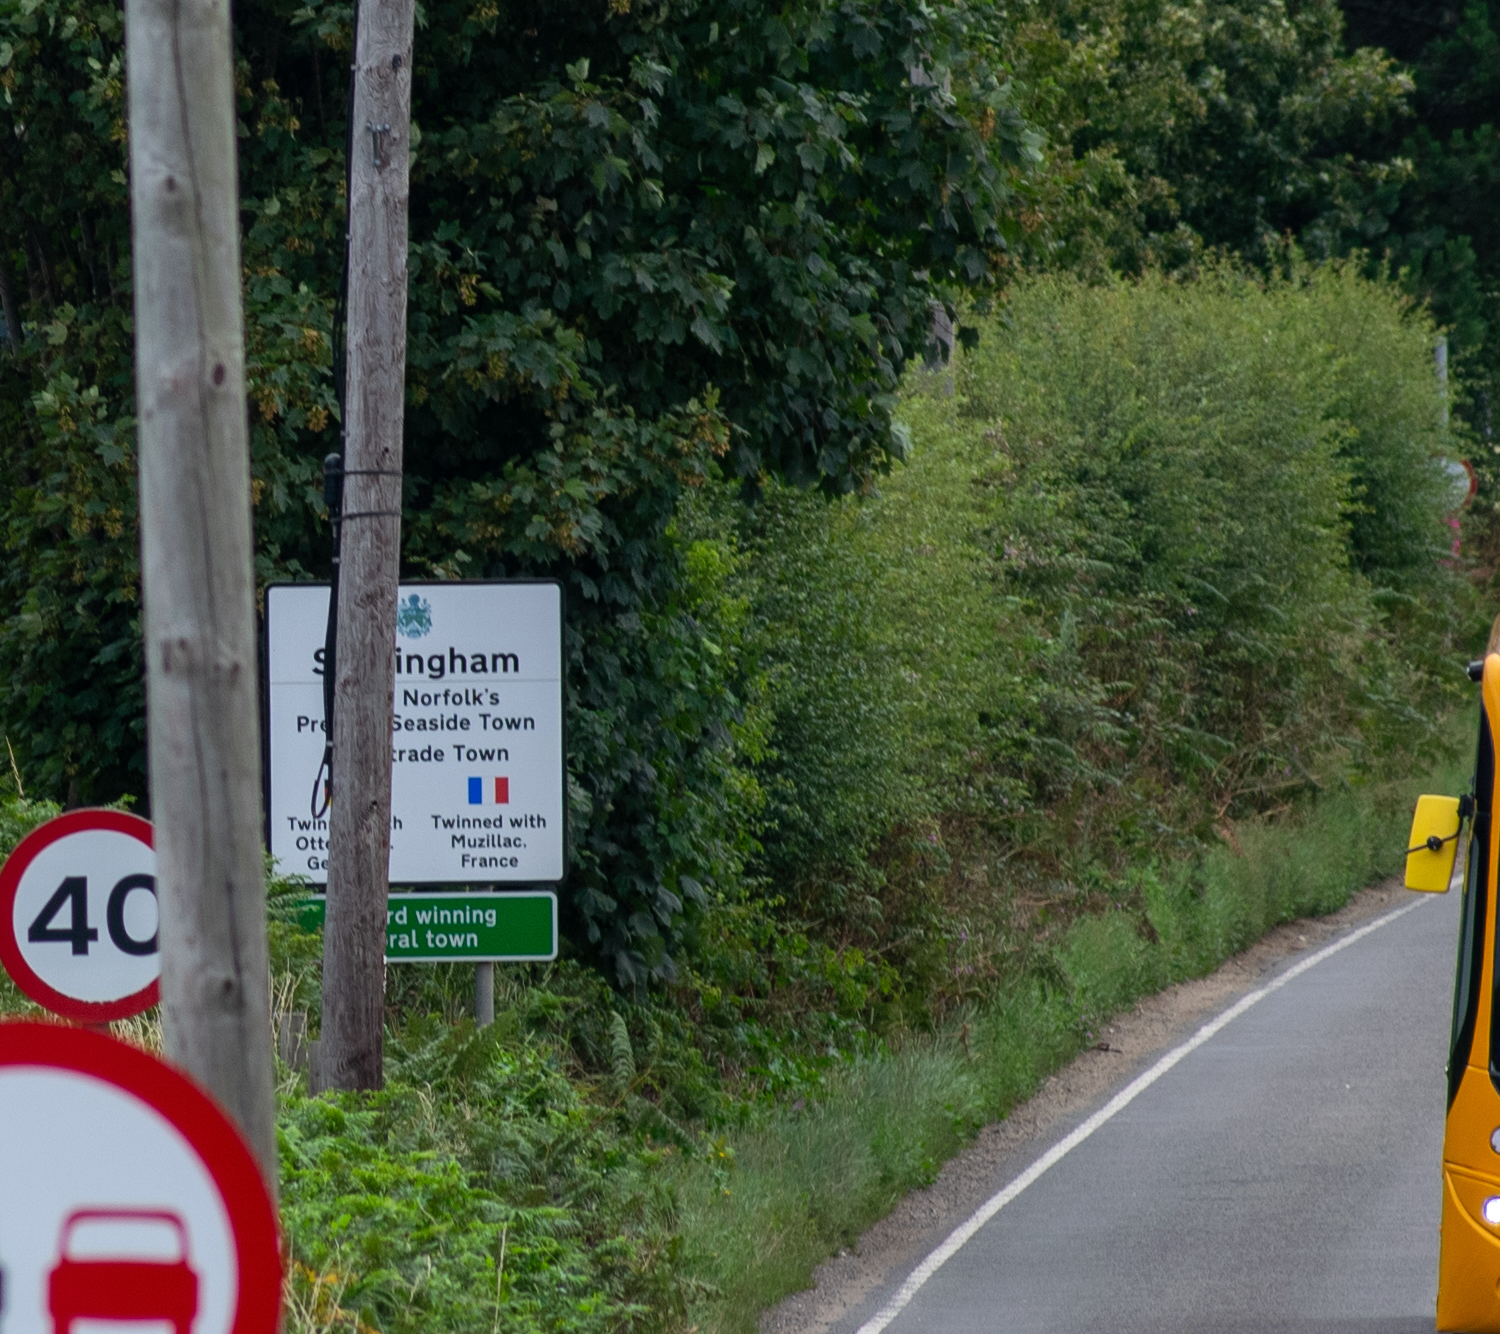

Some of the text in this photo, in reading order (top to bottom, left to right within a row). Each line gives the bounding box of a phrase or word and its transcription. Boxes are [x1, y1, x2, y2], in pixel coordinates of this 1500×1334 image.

[403, 688, 500, 706] Norfolk's
[392, 713, 536, 731] Seaside Town
[453, 745, 509, 762] Town
[431, 814, 547, 829] Twinned with
[461, 853, 518, 868] France
[27, 873, 159, 957] 40
[416, 905, 497, 928] winning
[426, 929, 478, 948] town
